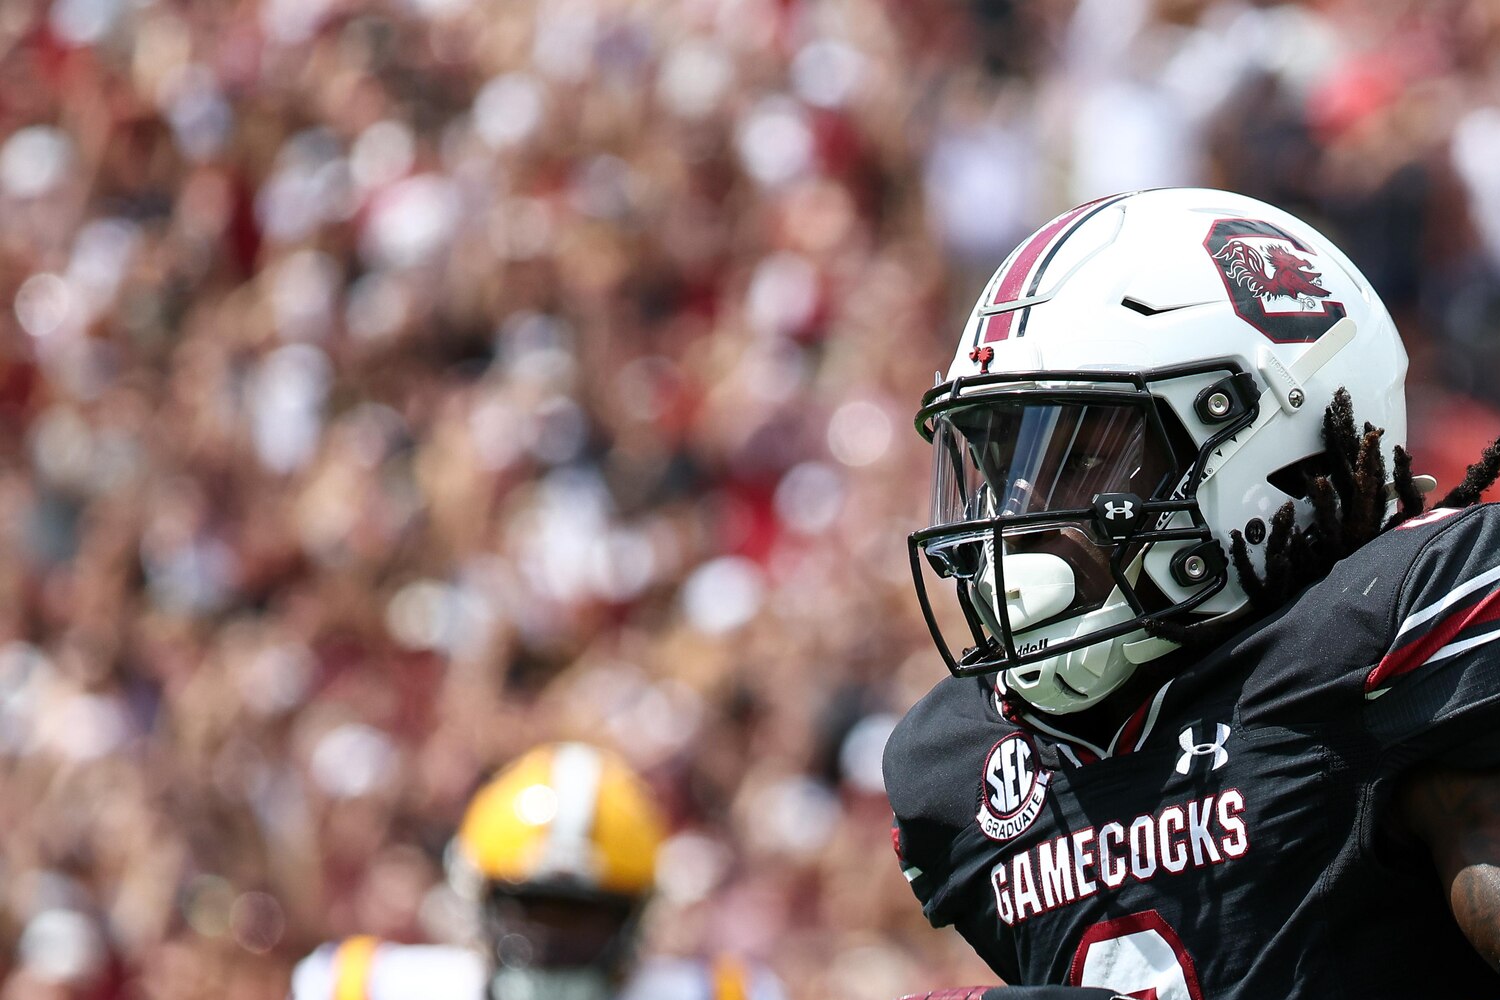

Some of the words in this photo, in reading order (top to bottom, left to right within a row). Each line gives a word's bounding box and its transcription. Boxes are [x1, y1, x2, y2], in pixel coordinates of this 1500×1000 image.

[986, 738, 1034, 813] SEC
[985, 792, 1042, 838] GRADUATE
[989, 787, 1250, 927] GAMECOCKS
